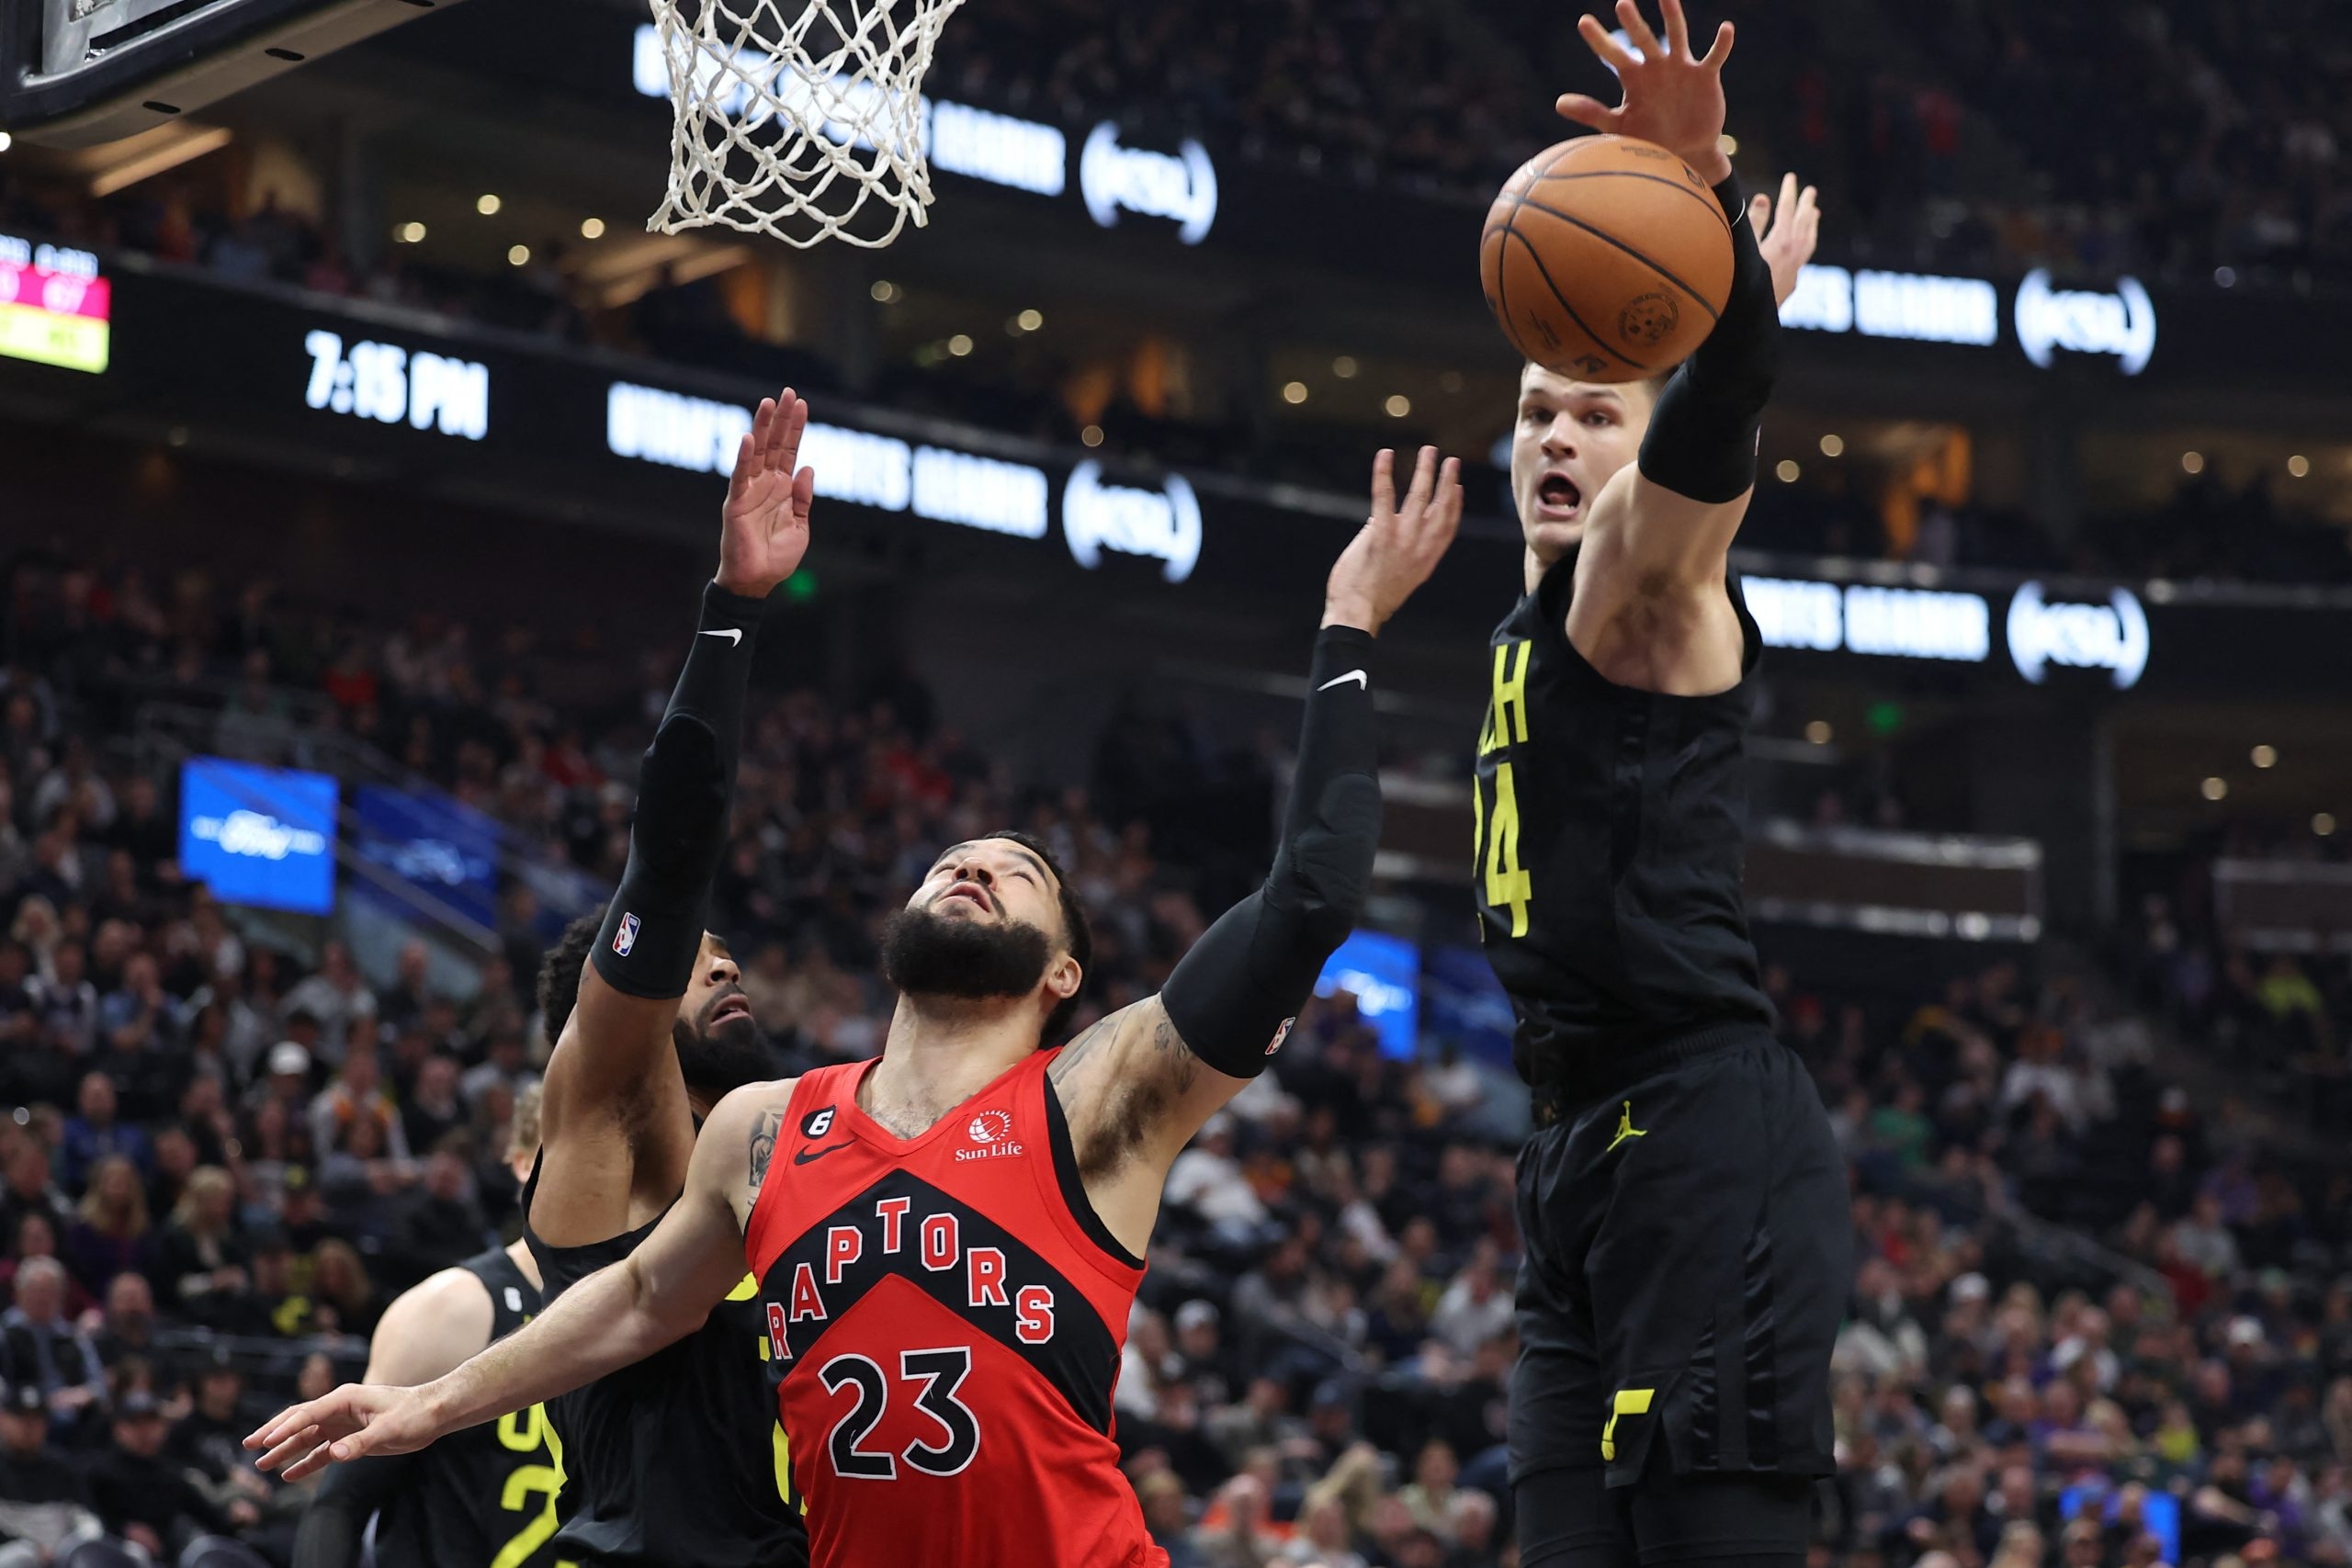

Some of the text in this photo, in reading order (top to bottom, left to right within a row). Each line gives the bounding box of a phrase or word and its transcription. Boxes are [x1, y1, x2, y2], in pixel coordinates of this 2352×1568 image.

[305, 329, 490, 441] 7:15 PM
[808, 1110, 831, 1137] 6
[956, 1140, 1023, 1162] Sun Life
[766, 1196, 1055, 1360] RAPTORS
[818, 1347, 980, 1480] 23
